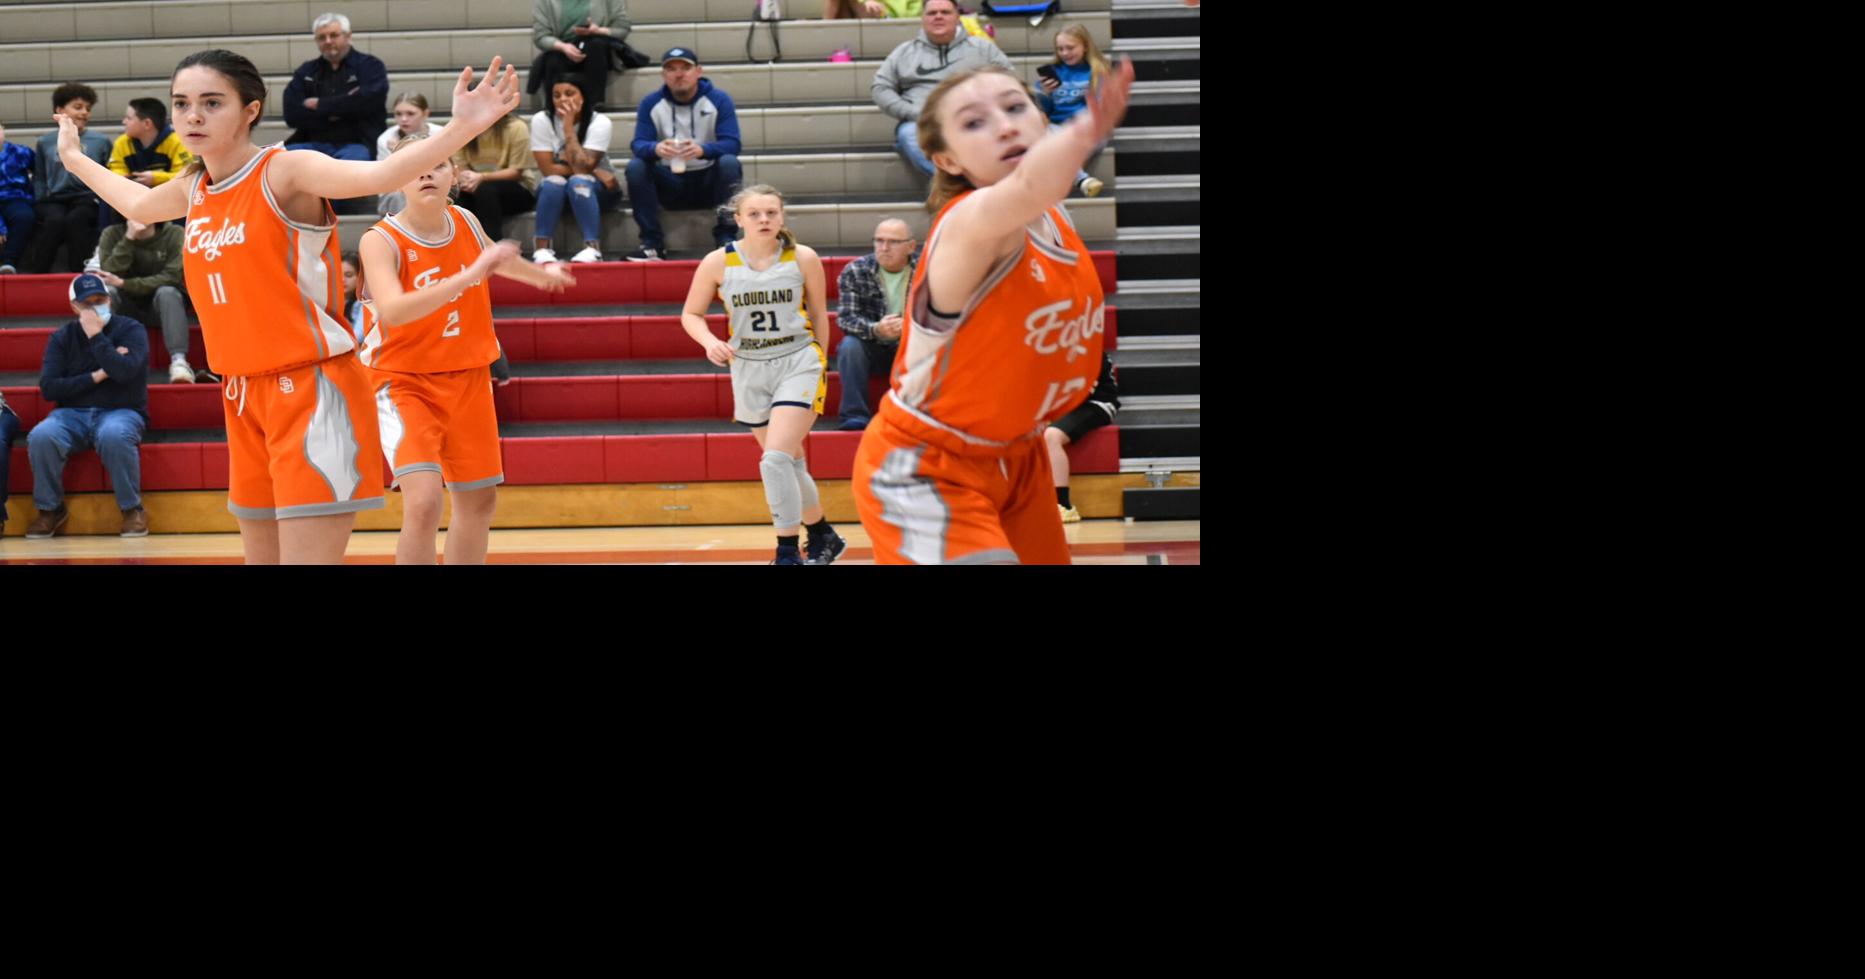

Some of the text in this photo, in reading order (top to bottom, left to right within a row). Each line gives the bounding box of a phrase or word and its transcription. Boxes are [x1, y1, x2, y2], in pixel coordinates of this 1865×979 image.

[186, 217, 245, 261] Eagles
[208, 273, 227, 304] 11
[731, 288, 793, 307] CLOUDLAND
[442, 310, 460, 336] 2
[750, 311, 780, 331] 21
